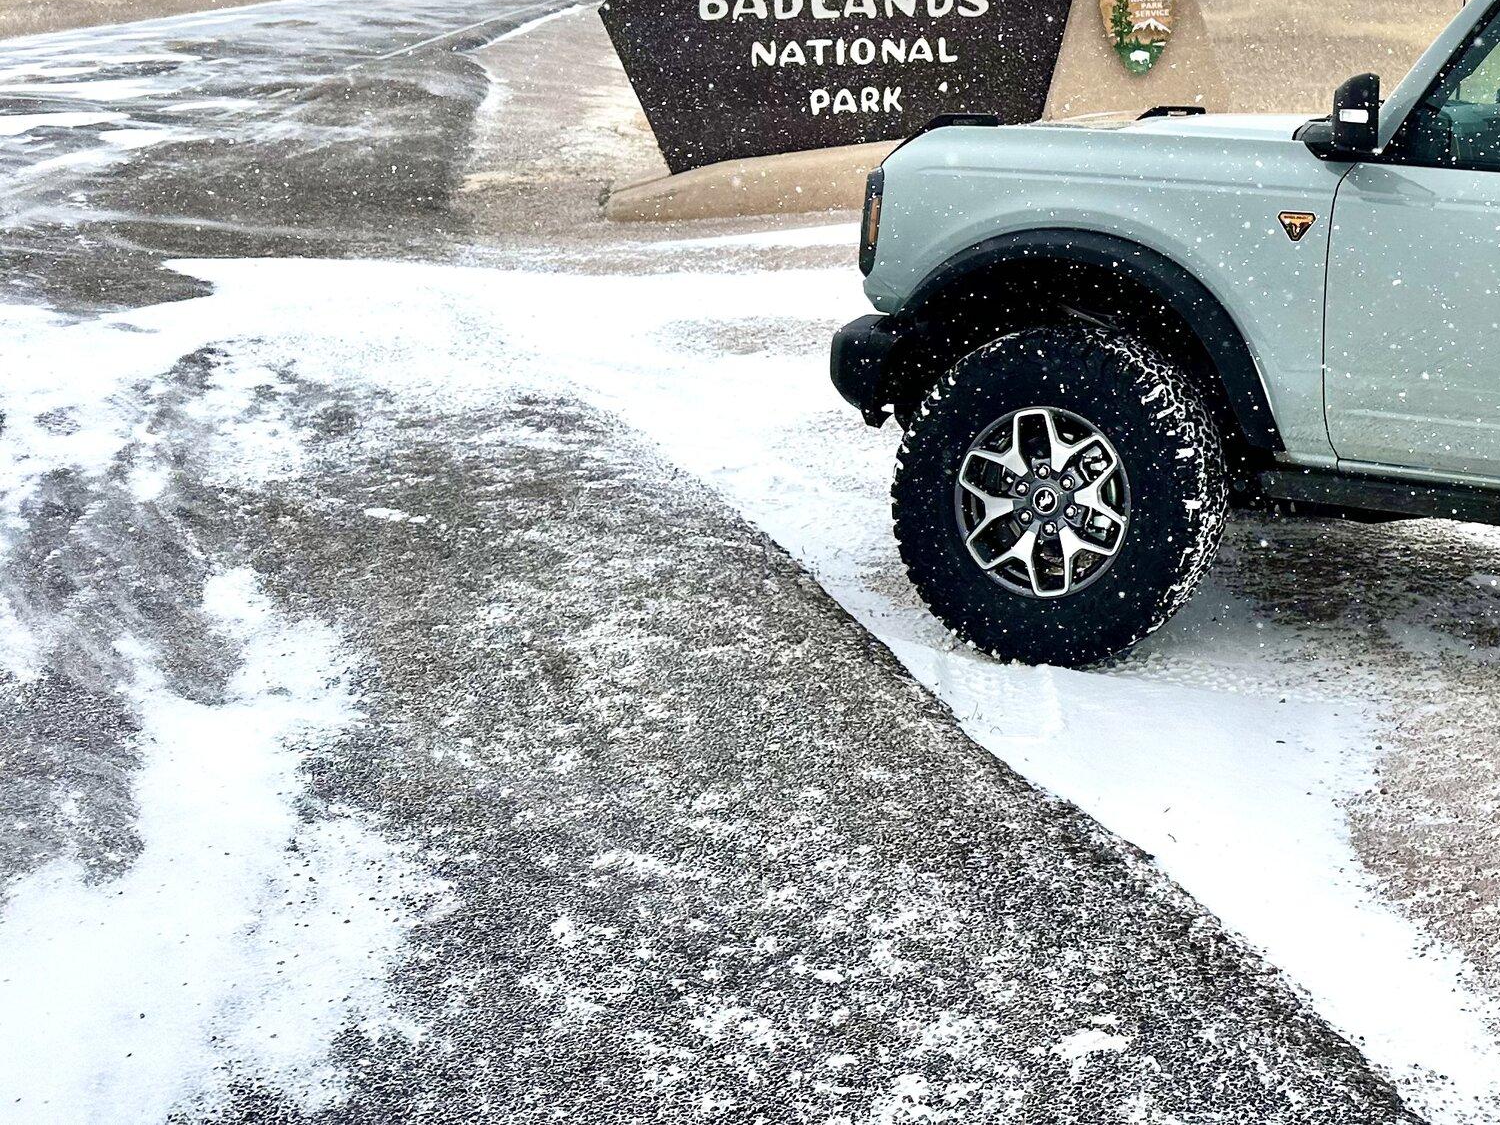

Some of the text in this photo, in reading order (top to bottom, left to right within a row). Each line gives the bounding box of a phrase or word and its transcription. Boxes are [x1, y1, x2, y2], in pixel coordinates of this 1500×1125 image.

[1135, 9, 1170, 18] SERVICE
[751, 36, 958, 68] NATIONAL
[810, 86, 903, 116] PARK
